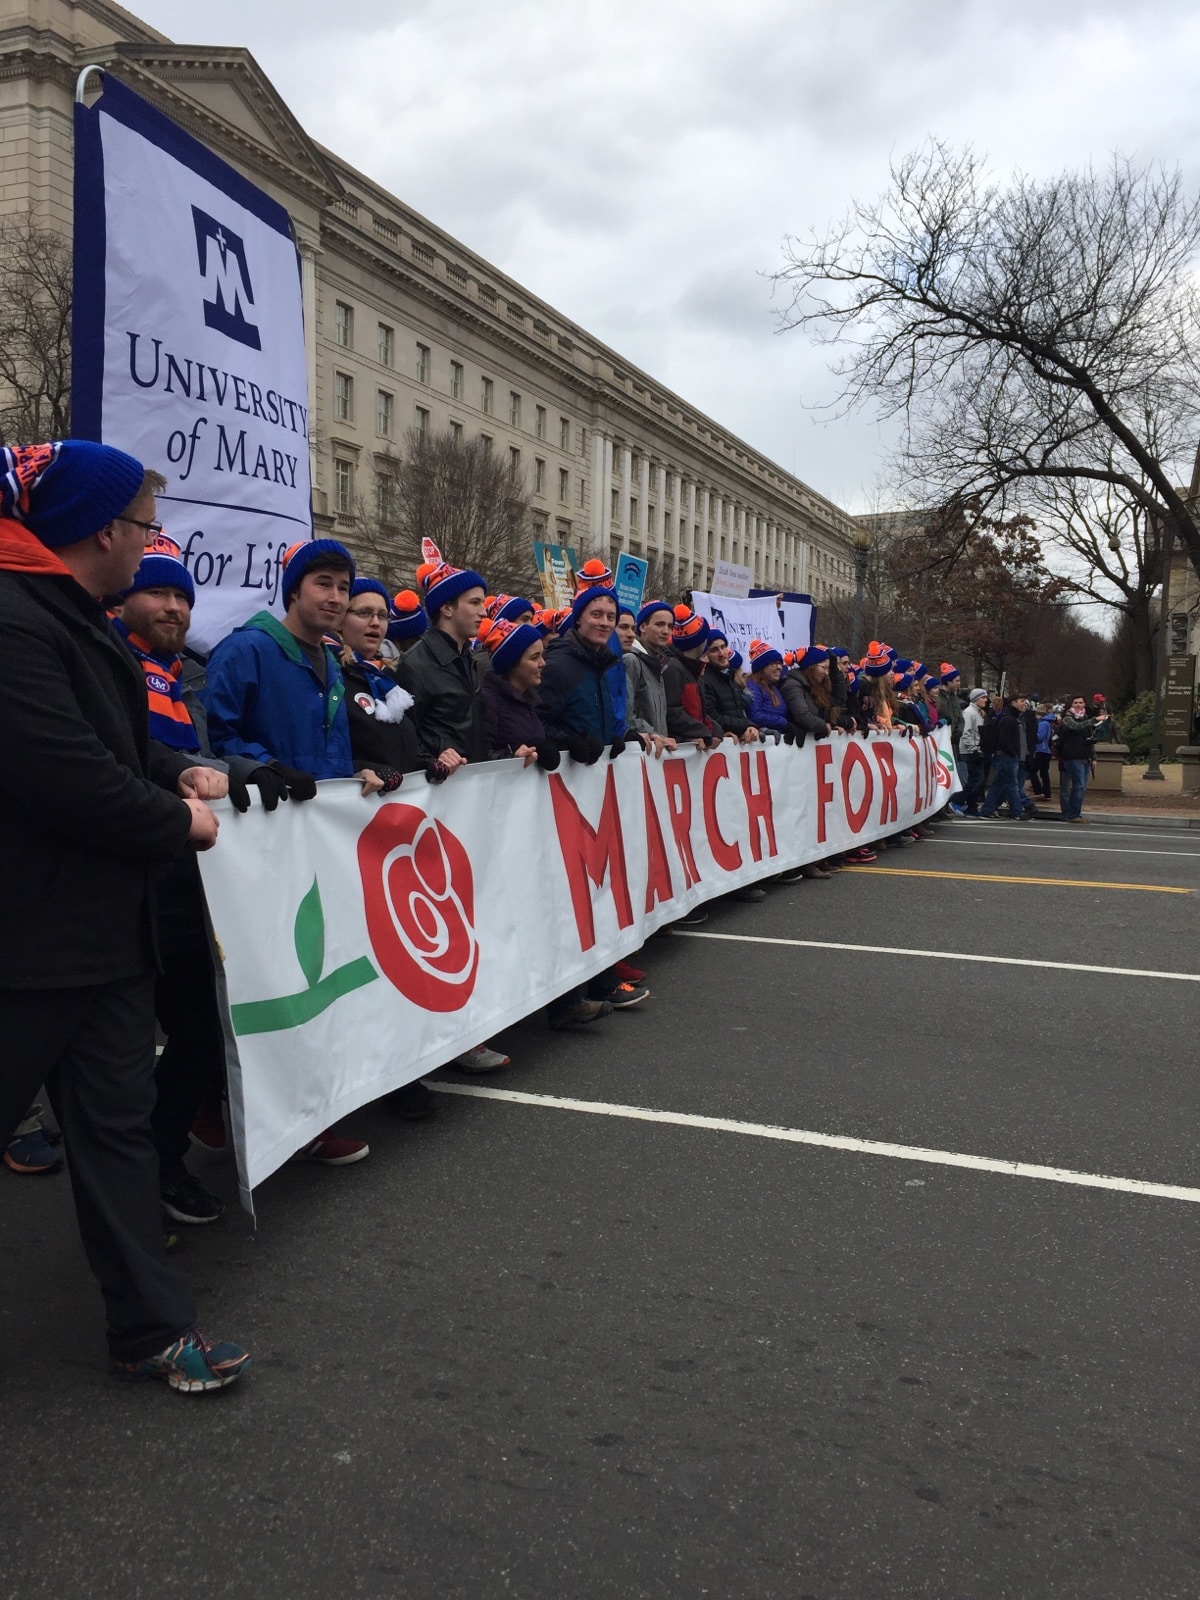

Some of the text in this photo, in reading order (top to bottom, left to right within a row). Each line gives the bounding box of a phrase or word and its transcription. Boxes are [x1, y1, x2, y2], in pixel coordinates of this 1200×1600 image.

[126, 331, 308, 438] UNIVERSITY
[167, 417, 298, 489] of MARY
[181, 531, 288, 606] for Lif
[548, 750, 778, 952] MARCH
[815, 741, 898, 843] FOR
